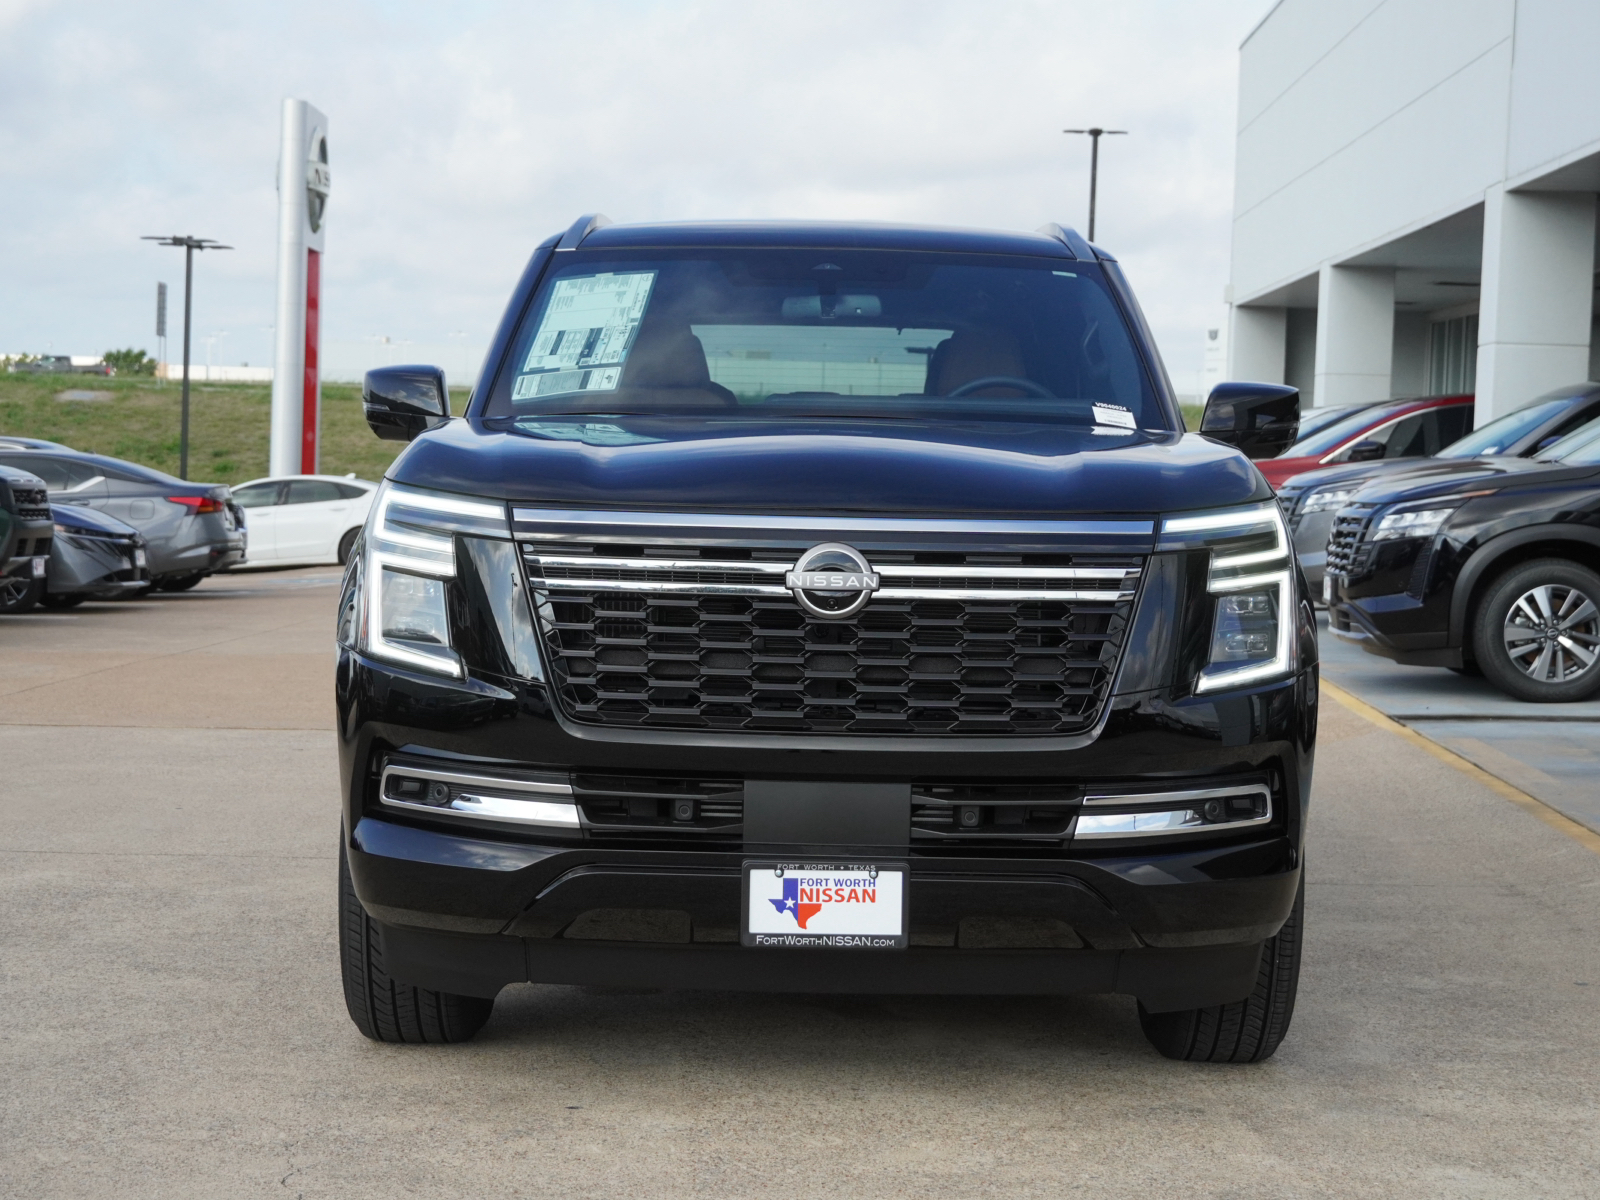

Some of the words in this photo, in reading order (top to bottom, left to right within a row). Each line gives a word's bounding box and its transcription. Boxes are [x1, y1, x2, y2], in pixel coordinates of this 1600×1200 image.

[789, 576, 876, 588] NISSAN
[799, 878, 830, 887] FORT
[833, 878, 876, 888] WORTH
[800, 888, 876, 903] NISSAN
